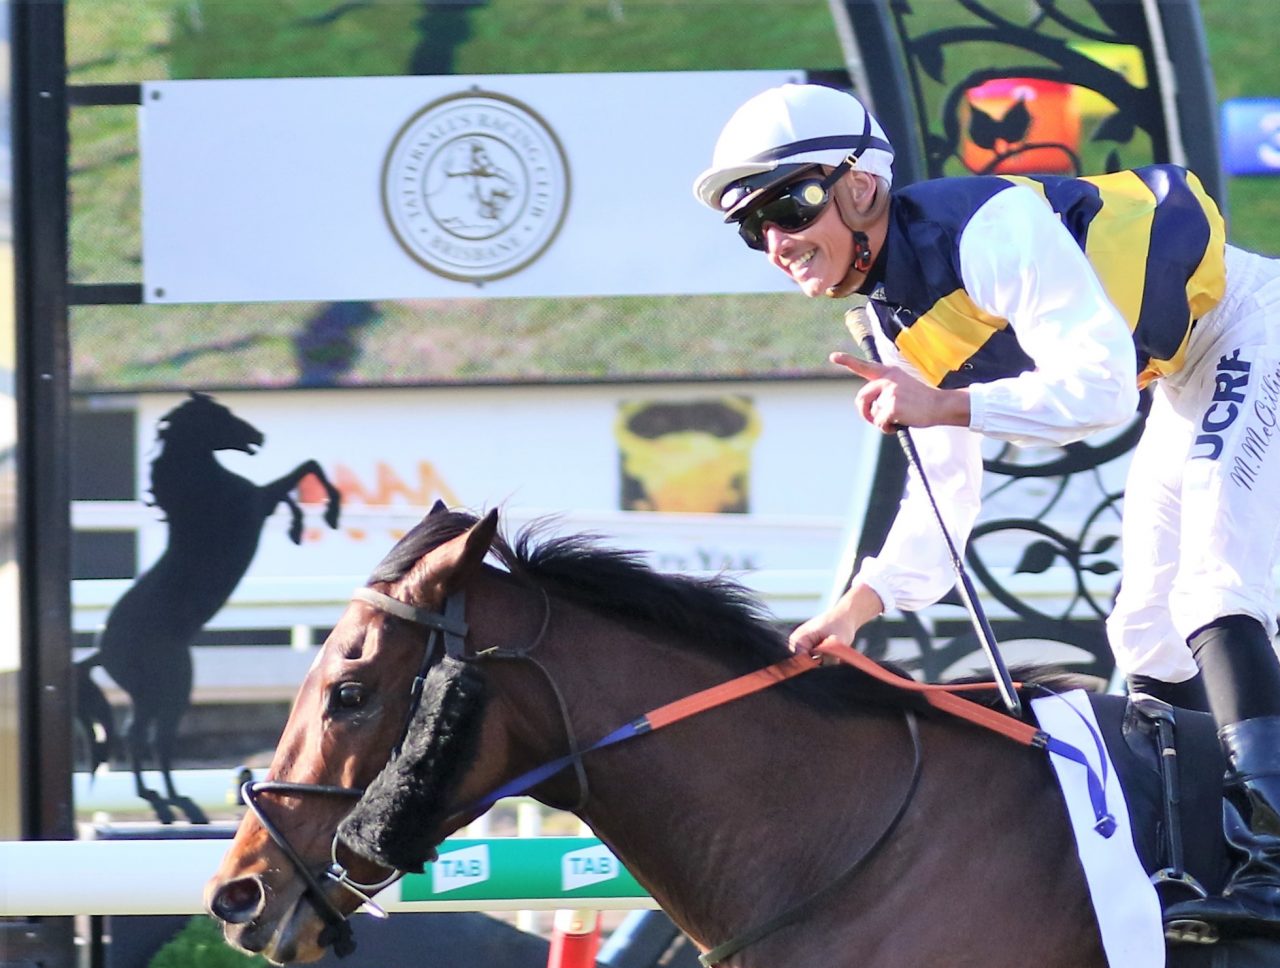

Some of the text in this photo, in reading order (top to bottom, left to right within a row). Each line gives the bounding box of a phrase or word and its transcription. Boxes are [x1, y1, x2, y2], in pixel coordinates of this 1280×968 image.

[1191, 348, 1252, 460] UCRF
[439, 859, 482, 877] TAB
[568, 856, 612, 875] TAB
